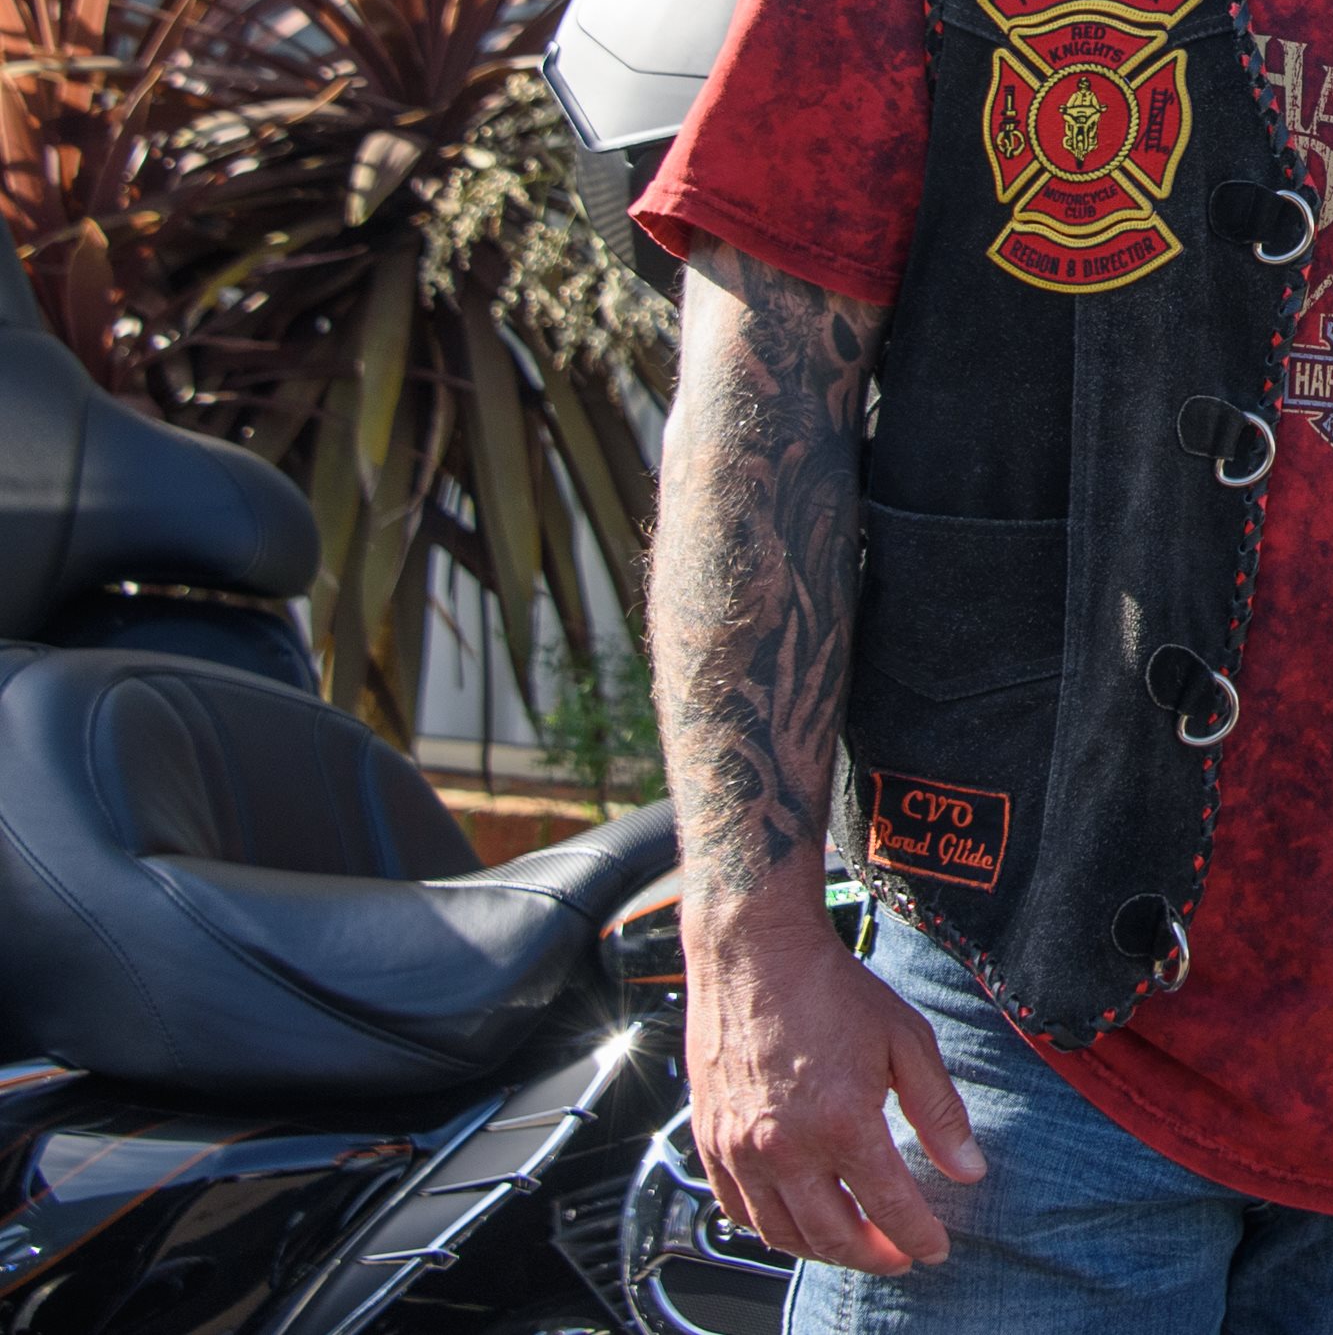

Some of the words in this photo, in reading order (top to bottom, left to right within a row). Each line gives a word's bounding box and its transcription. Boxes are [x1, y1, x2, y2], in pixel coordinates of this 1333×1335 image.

[1071, 25, 1106, 40] RED
[1048, 40, 1126, 65] KNIGHTS
[1042, 186, 1119, 206] MOTORCYCLE
[1064, 205, 1096, 218] CLUB
[1009, 238, 1060, 276] REGION
[1082, 238, 1157, 277] DIRECTOR
[902, 790, 973, 827] CVO
[875, 816, 931, 856] Road
[938, 833, 995, 870] Glide
